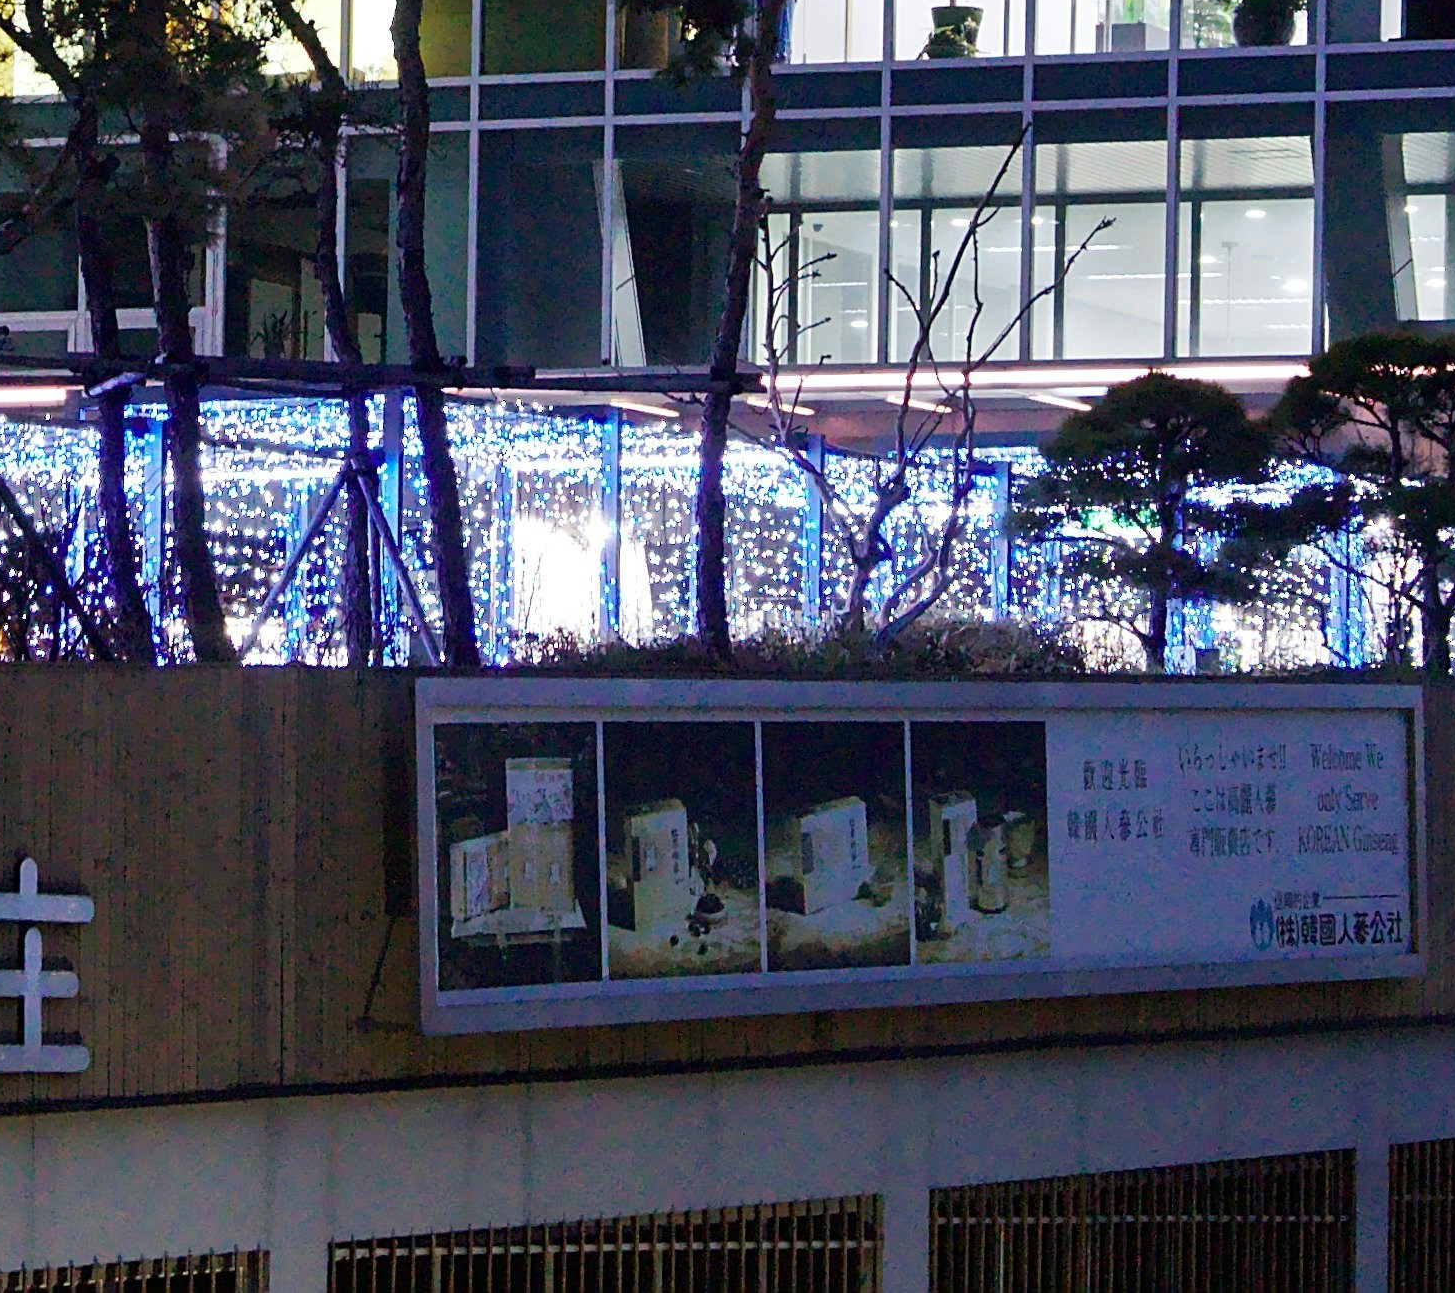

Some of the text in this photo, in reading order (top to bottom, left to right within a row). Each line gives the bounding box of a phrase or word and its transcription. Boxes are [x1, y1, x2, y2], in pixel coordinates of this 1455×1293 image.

[1310, 743, 1384, 770] Welcome We
[1297, 825, 1350, 853] KOREAN
